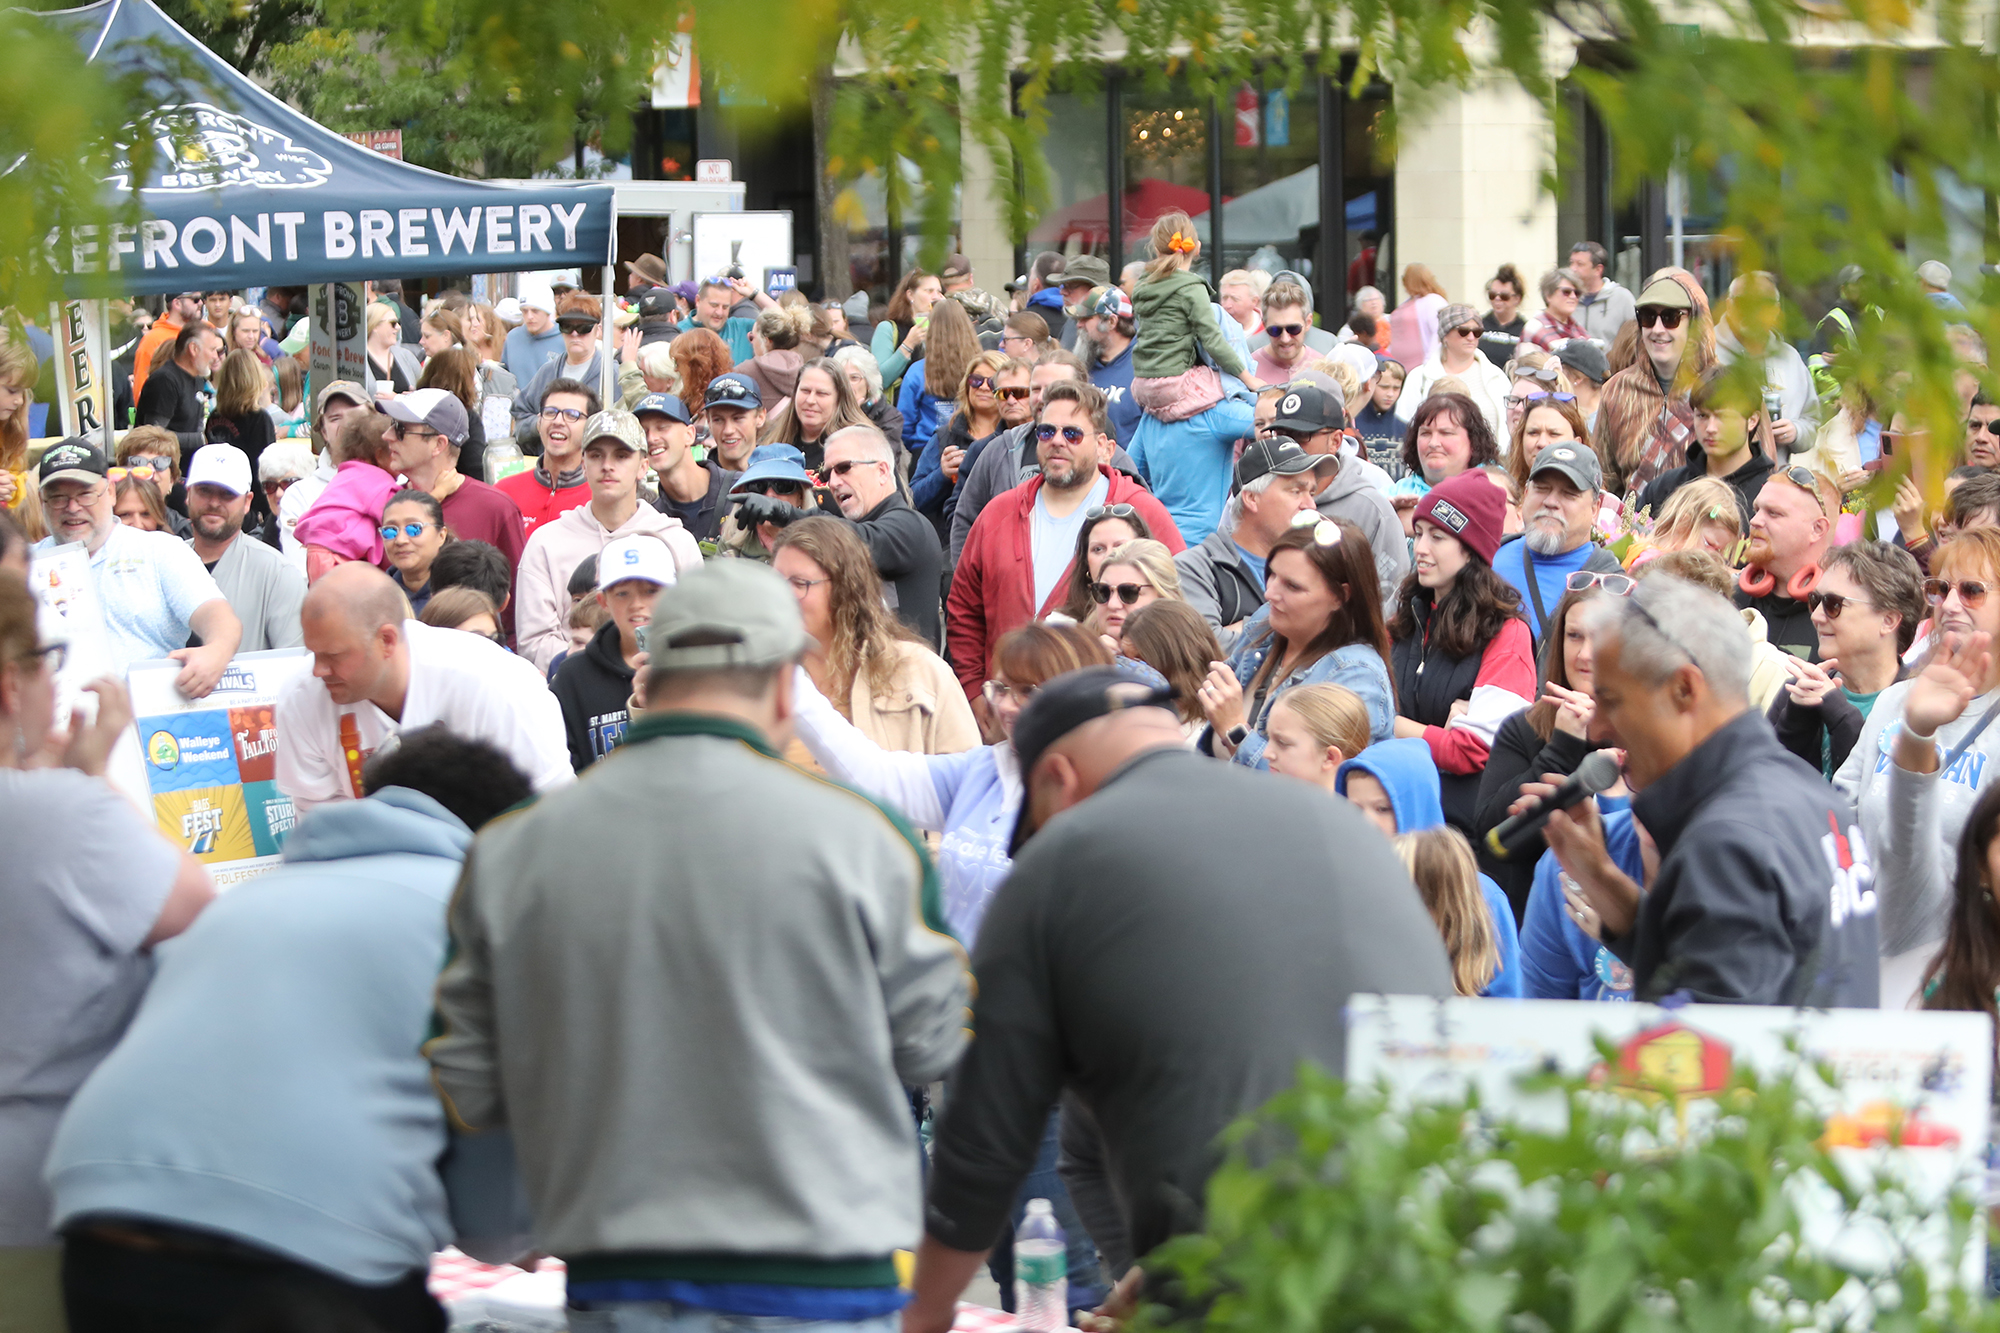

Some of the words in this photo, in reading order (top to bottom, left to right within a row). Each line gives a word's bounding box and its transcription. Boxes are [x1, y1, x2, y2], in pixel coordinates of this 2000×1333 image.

[161, 167, 287, 187] BREWERY
[324, 203, 587, 260] BREWERY
[770, 274, 795, 286] ATM
[624, 549, 639, 565] S
[179, 735, 221, 749] Walleye
[183, 748, 230, 763] Weekend
[193, 798, 210, 813] BAGS
[182, 807, 223, 838] FEST
